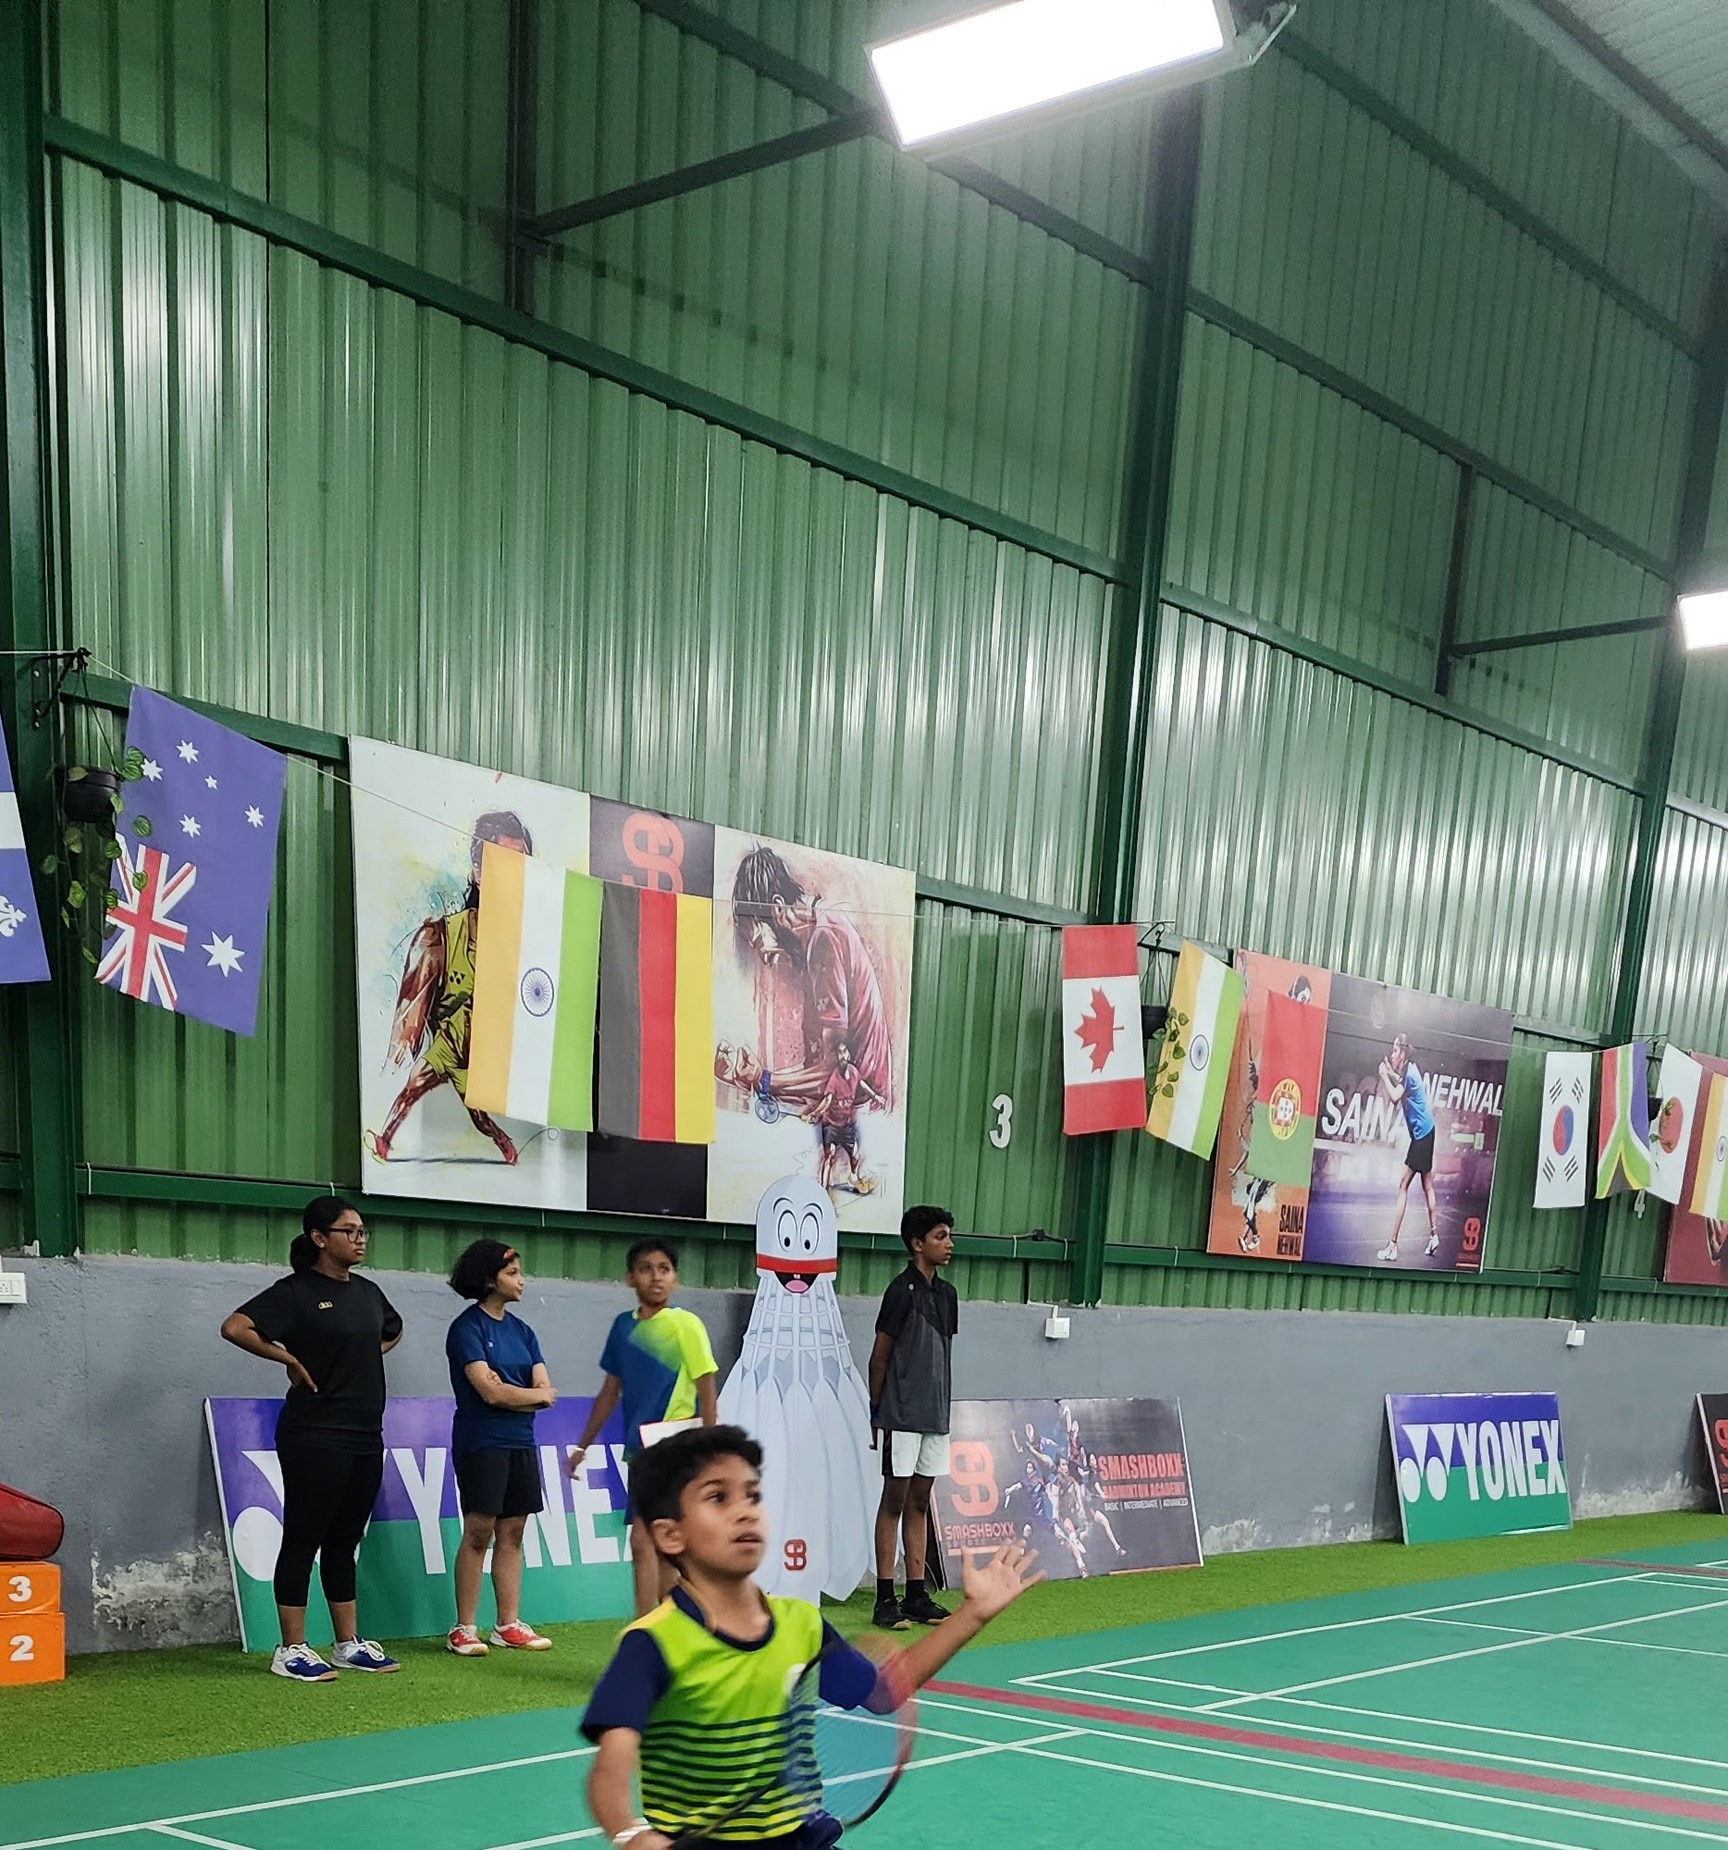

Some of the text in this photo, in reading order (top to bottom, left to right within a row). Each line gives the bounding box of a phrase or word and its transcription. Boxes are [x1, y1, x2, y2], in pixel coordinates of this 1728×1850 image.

[989, 1093, 1013, 1149] 3
[1321, 1071, 1503, 1146] SAINA NEHWAL
[1279, 1203, 1304, 1234] SAINA
[1097, 1452, 1185, 1481] SMASHBOXX
[1455, 1419, 1567, 1501] YONEX
[944, 1521, 1016, 1541] SMASHBOXX
[8, 1575, 32, 1602] 3
[9, 1635, 34, 1662] 2
